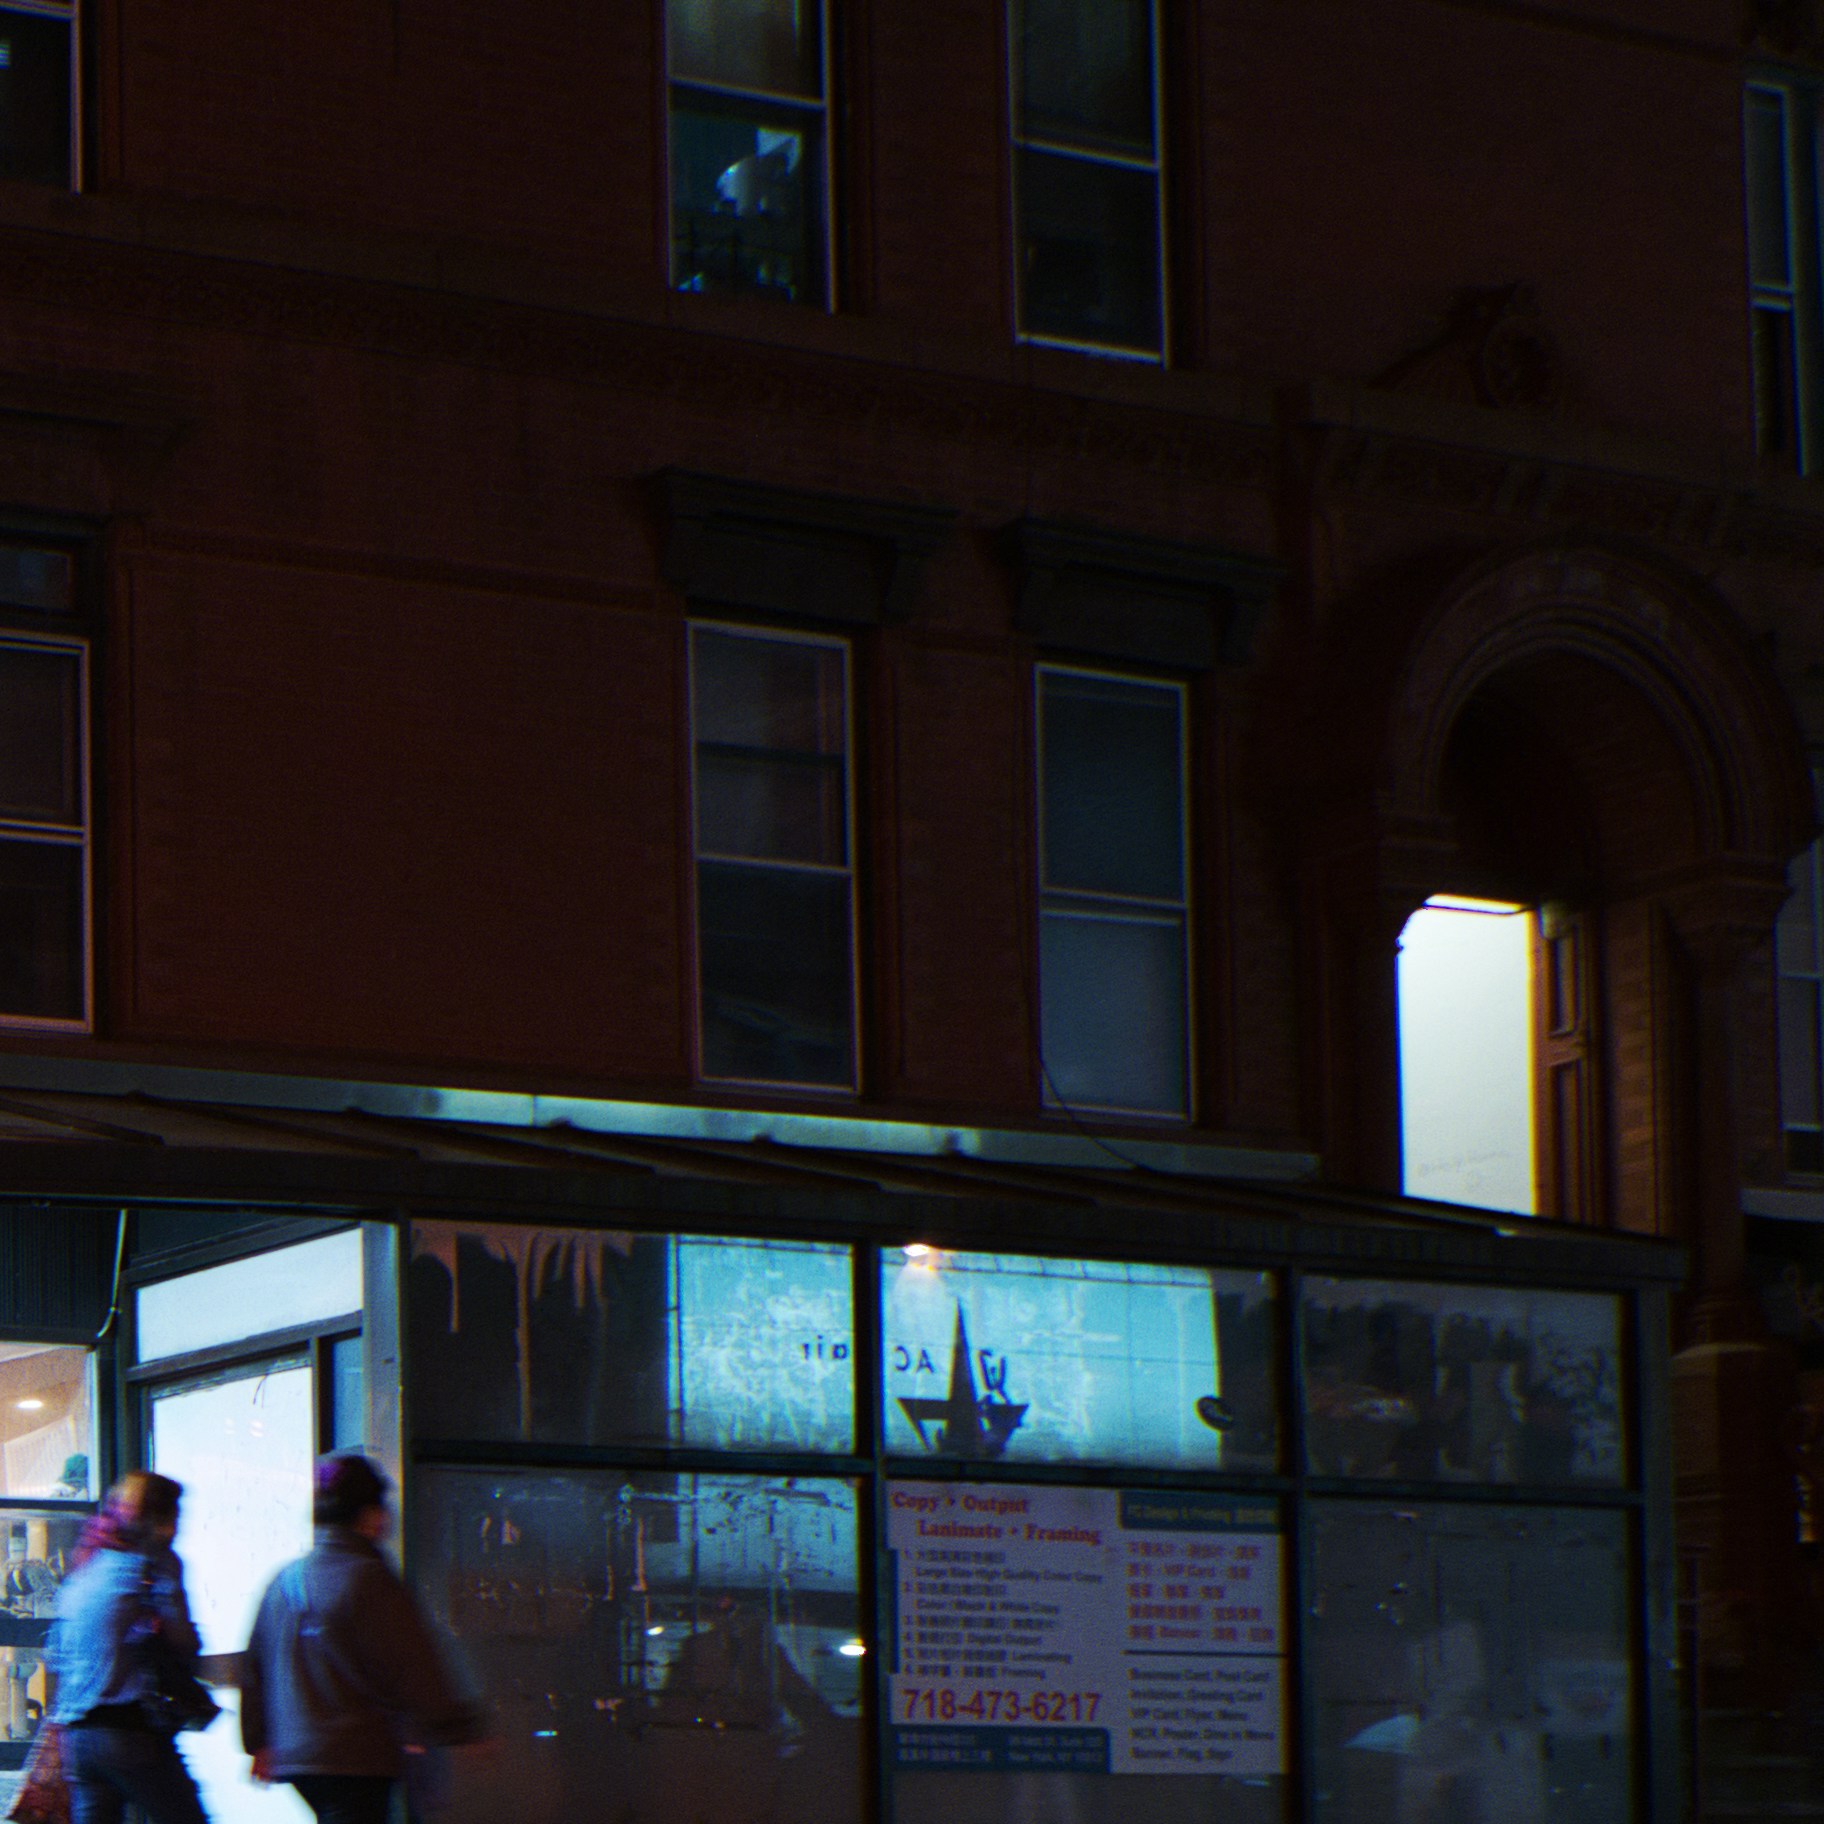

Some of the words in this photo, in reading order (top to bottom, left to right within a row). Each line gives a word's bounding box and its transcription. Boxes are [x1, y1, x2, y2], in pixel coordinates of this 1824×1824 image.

[891, 1491, 939, 1513] Copy
[962, 1494, 1030, 1516] Output
[917, 1519, 1003, 1539] Lanimate
[1024, 1522, 1102, 1546] Framing
[901, 1688, 1102, 1722] 718-473-6217
